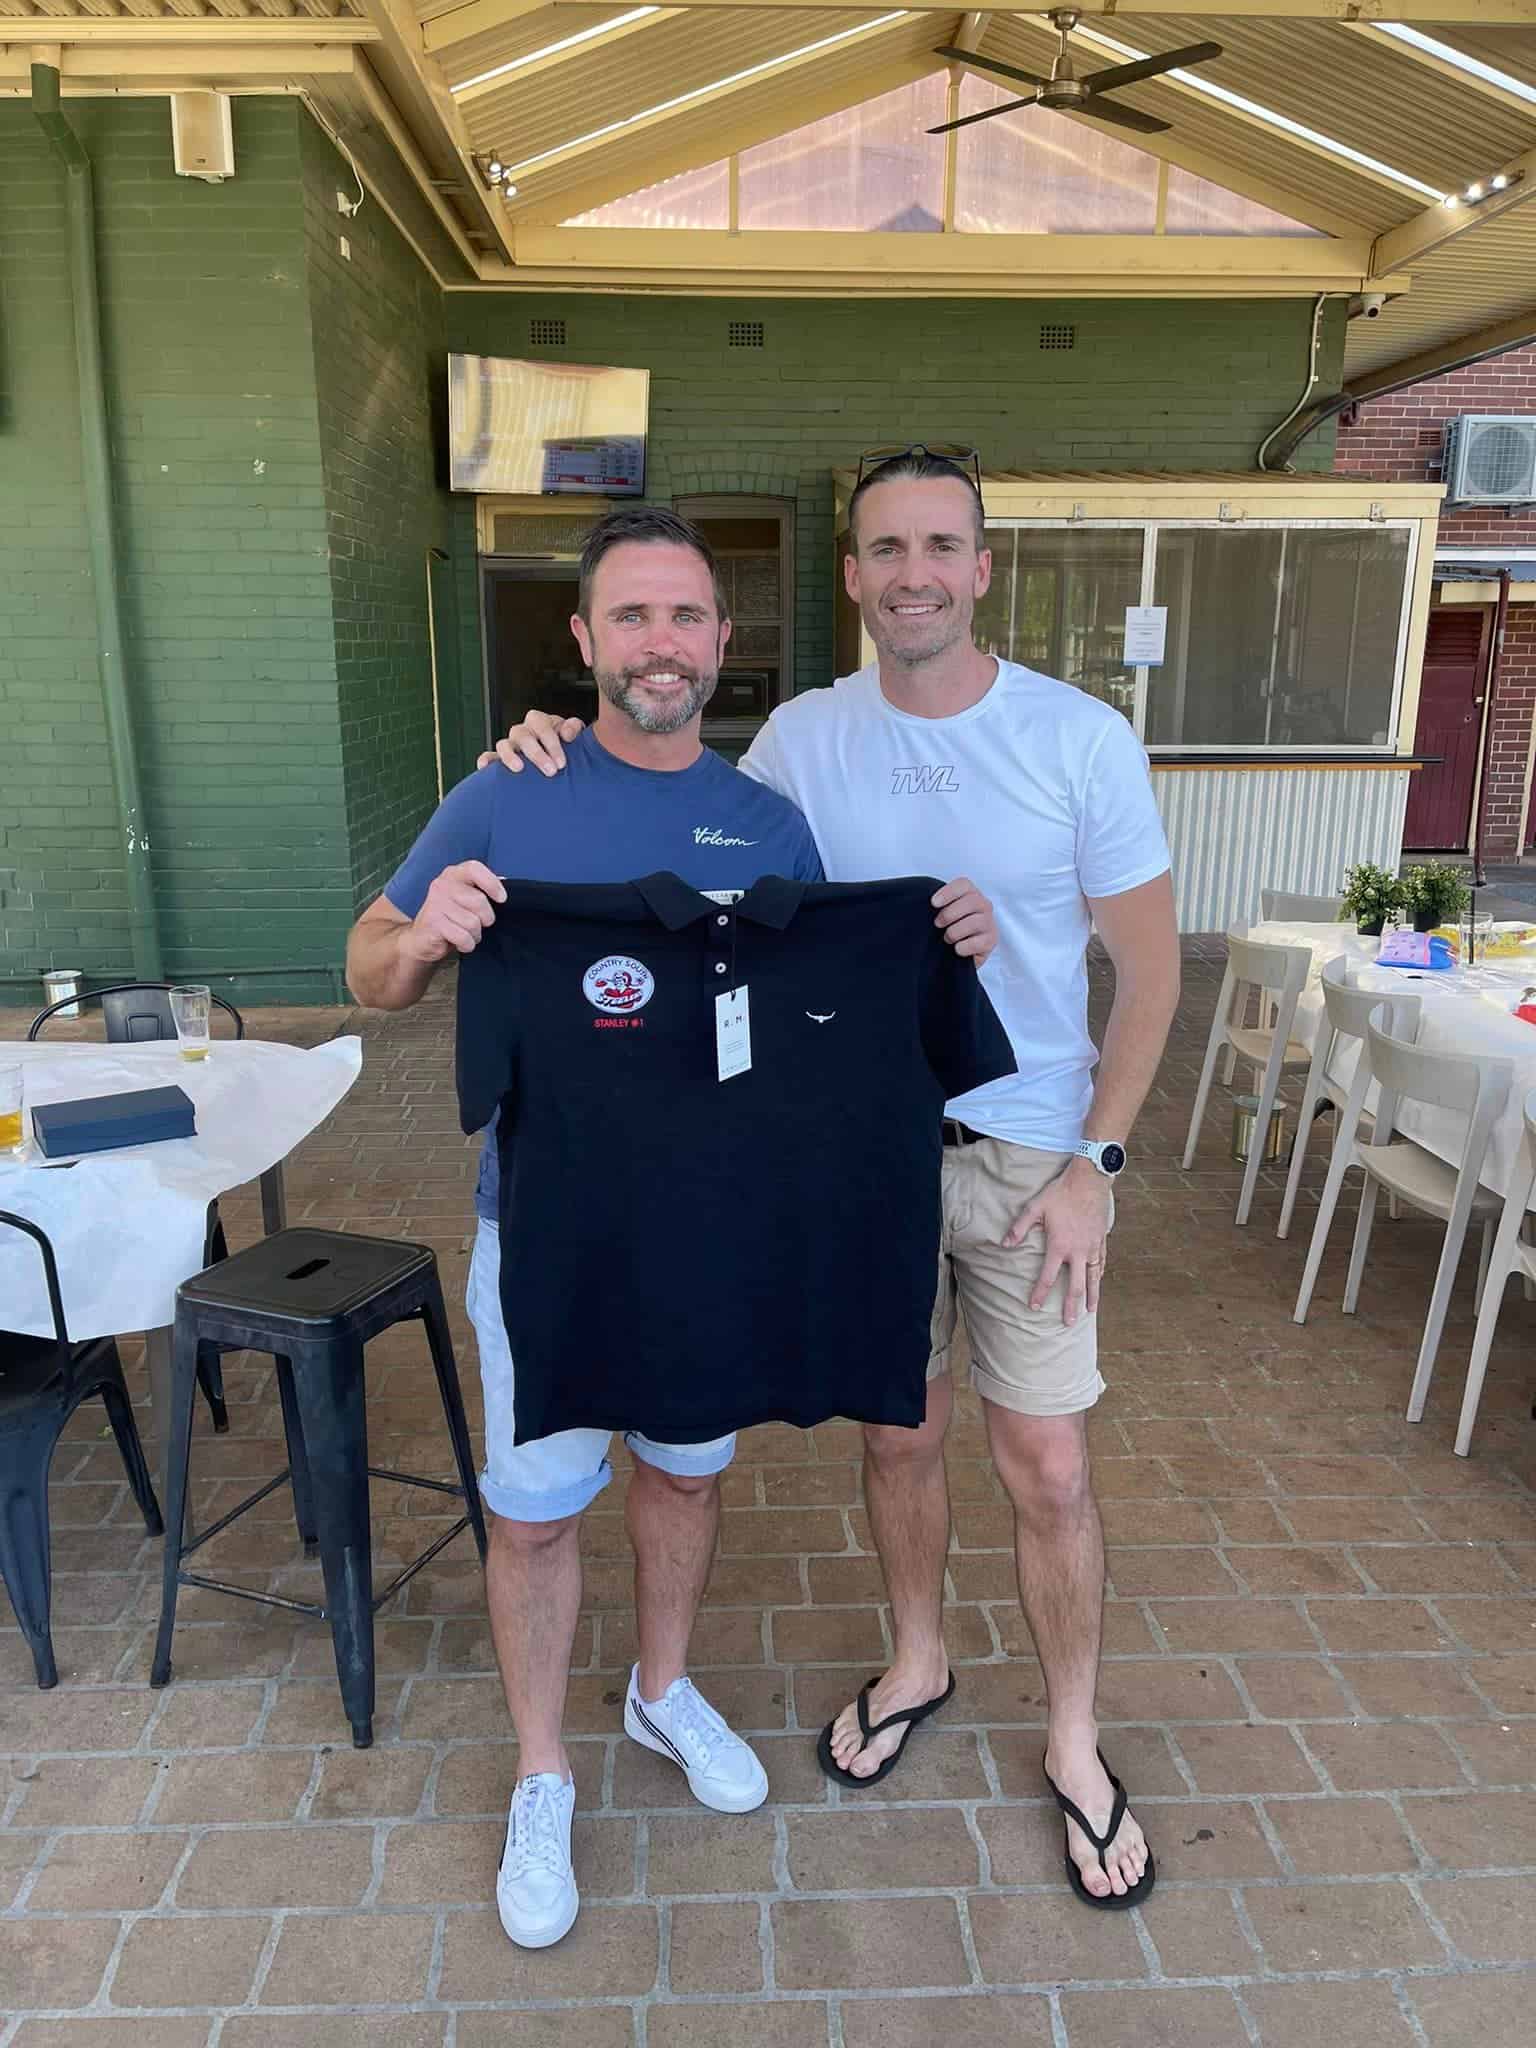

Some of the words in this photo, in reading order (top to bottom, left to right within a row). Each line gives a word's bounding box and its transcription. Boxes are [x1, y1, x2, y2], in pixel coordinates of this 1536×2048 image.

[891, 765, 960, 794] TWL
[692, 827, 760, 847] Volcom
[588, 959, 624, 980] COUNTRY
[594, 1018, 629, 1029] STANLEY
